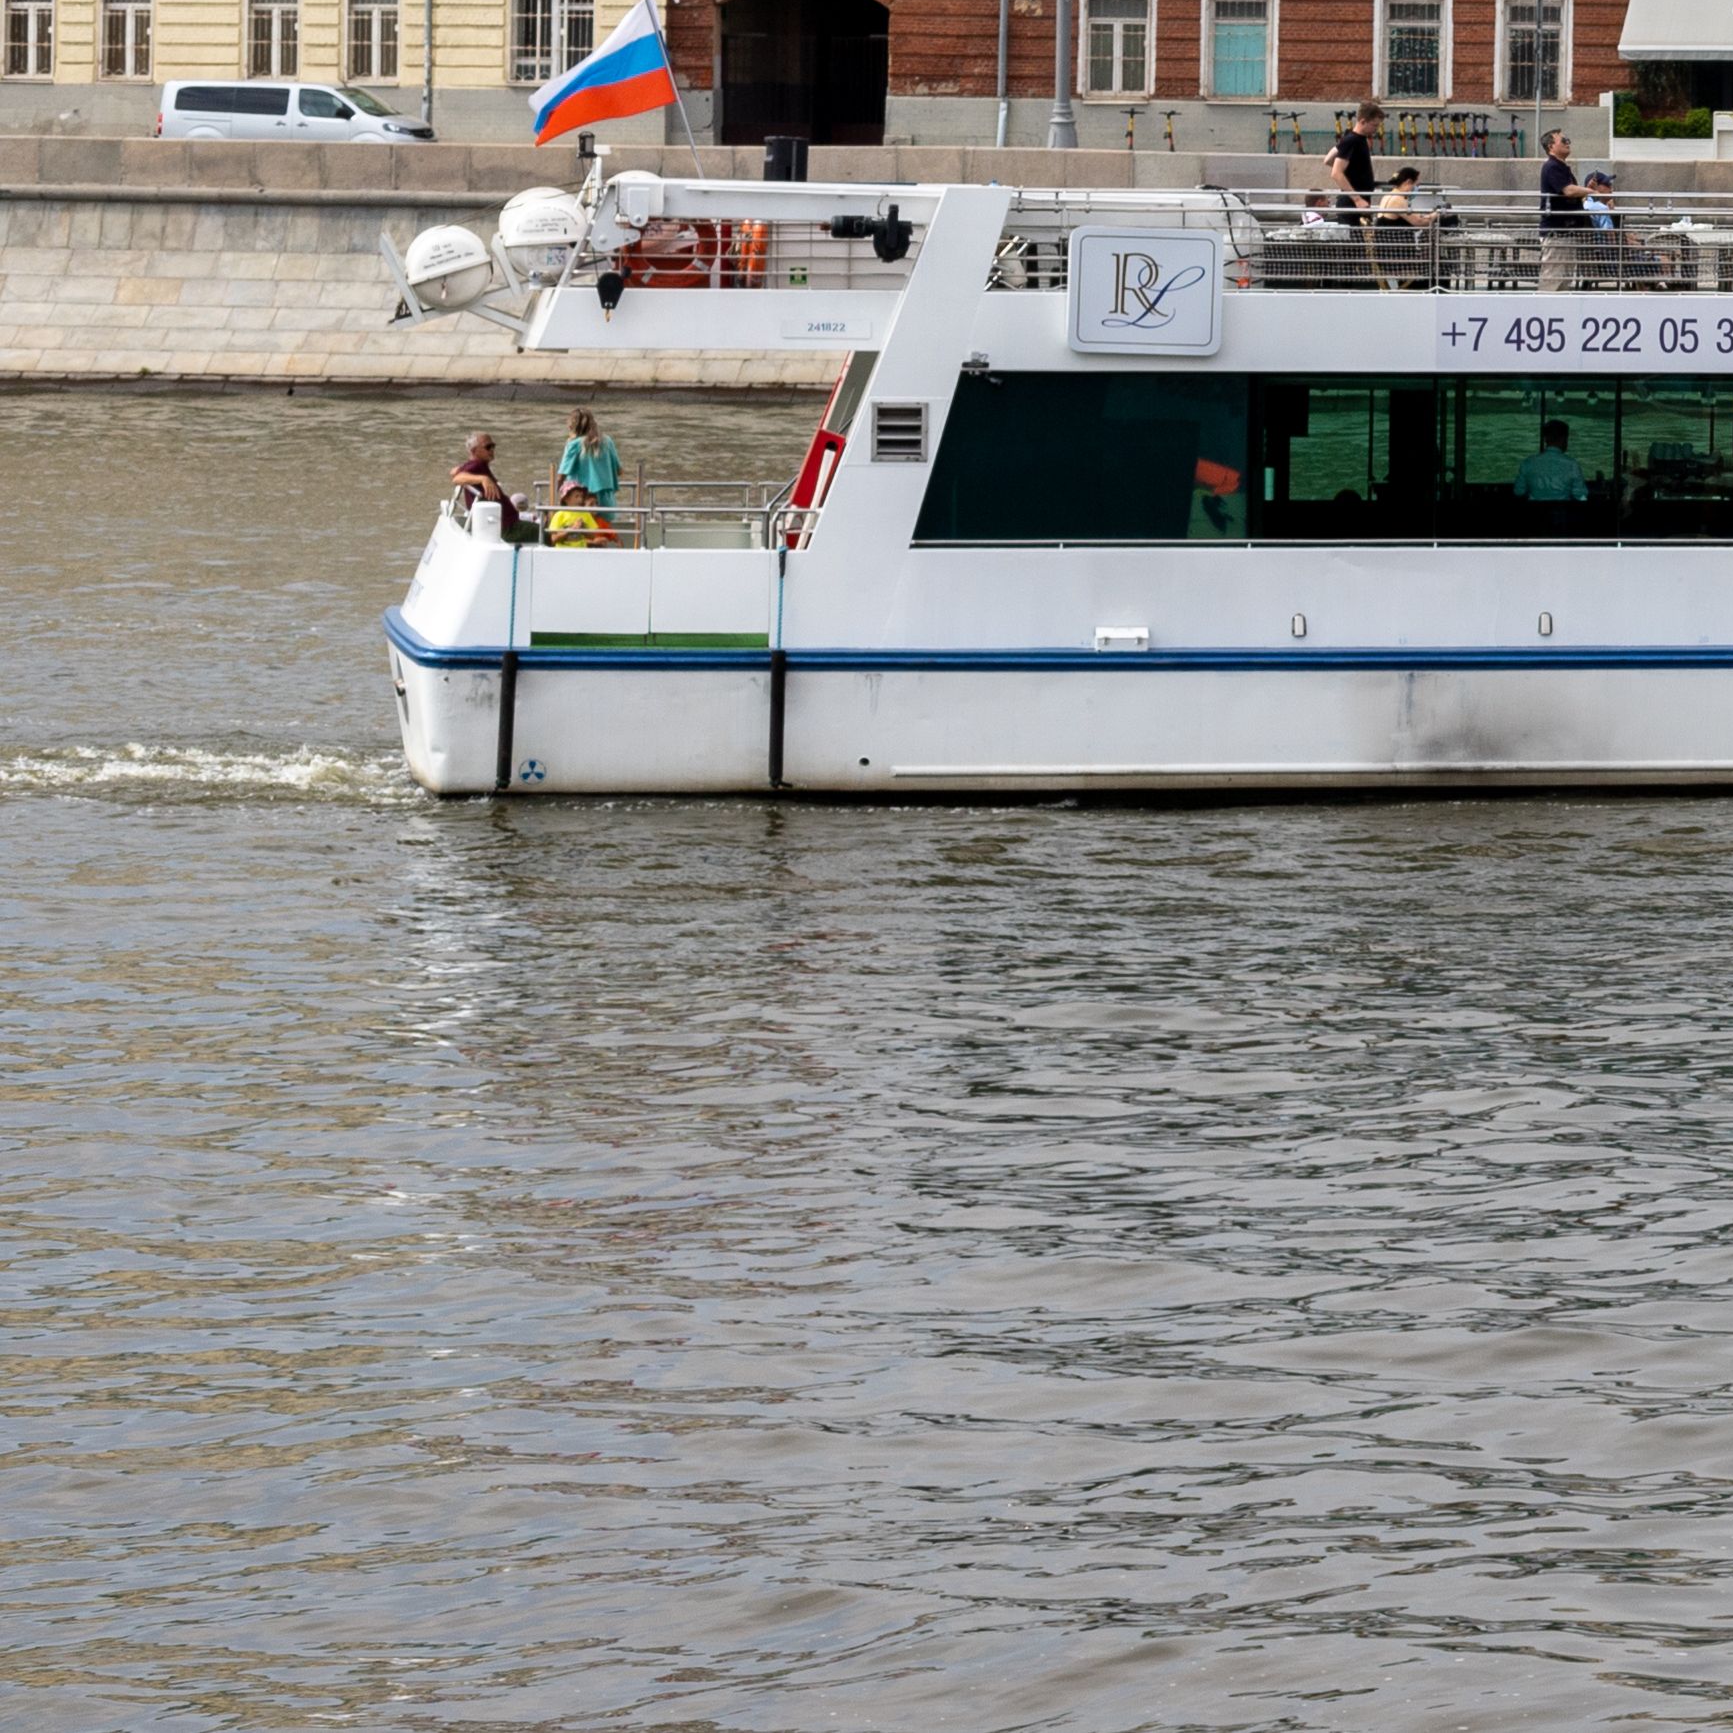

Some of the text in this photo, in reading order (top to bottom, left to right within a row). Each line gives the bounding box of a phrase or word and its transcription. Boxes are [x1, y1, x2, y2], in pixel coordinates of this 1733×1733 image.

[807, 321, 846, 333] 241822
[1441, 317, 1488, 353] +7
[1503, 317, 1567, 353] 495
[1580, 317, 1642, 353] 222
[1658, 318, 1700, 354] 05
